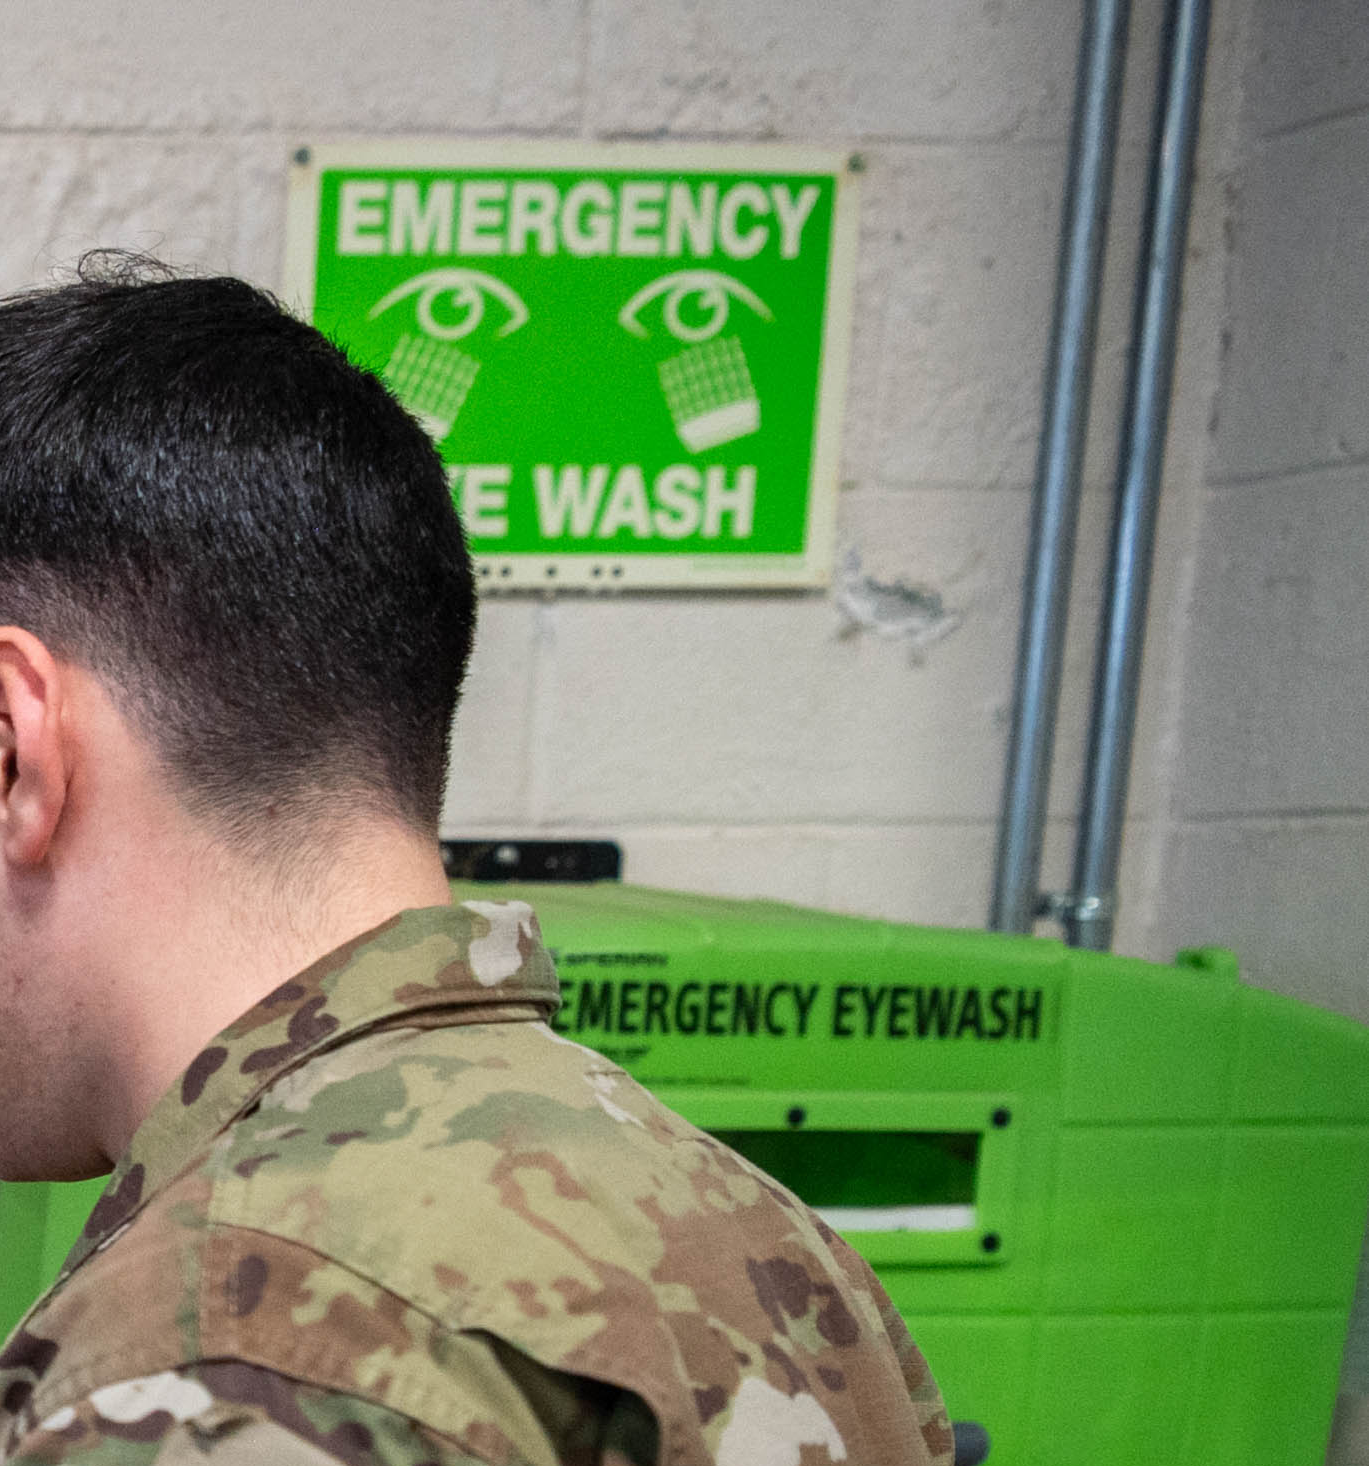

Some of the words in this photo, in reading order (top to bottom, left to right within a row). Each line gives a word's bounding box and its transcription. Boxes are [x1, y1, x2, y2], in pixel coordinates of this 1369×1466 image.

[336, 178, 821, 260] EMERGENCY
[533, 463, 758, 540] WASH
[550, 979, 820, 1038] EMERGENCY
[830, 984, 1043, 1042] EYEWASH
